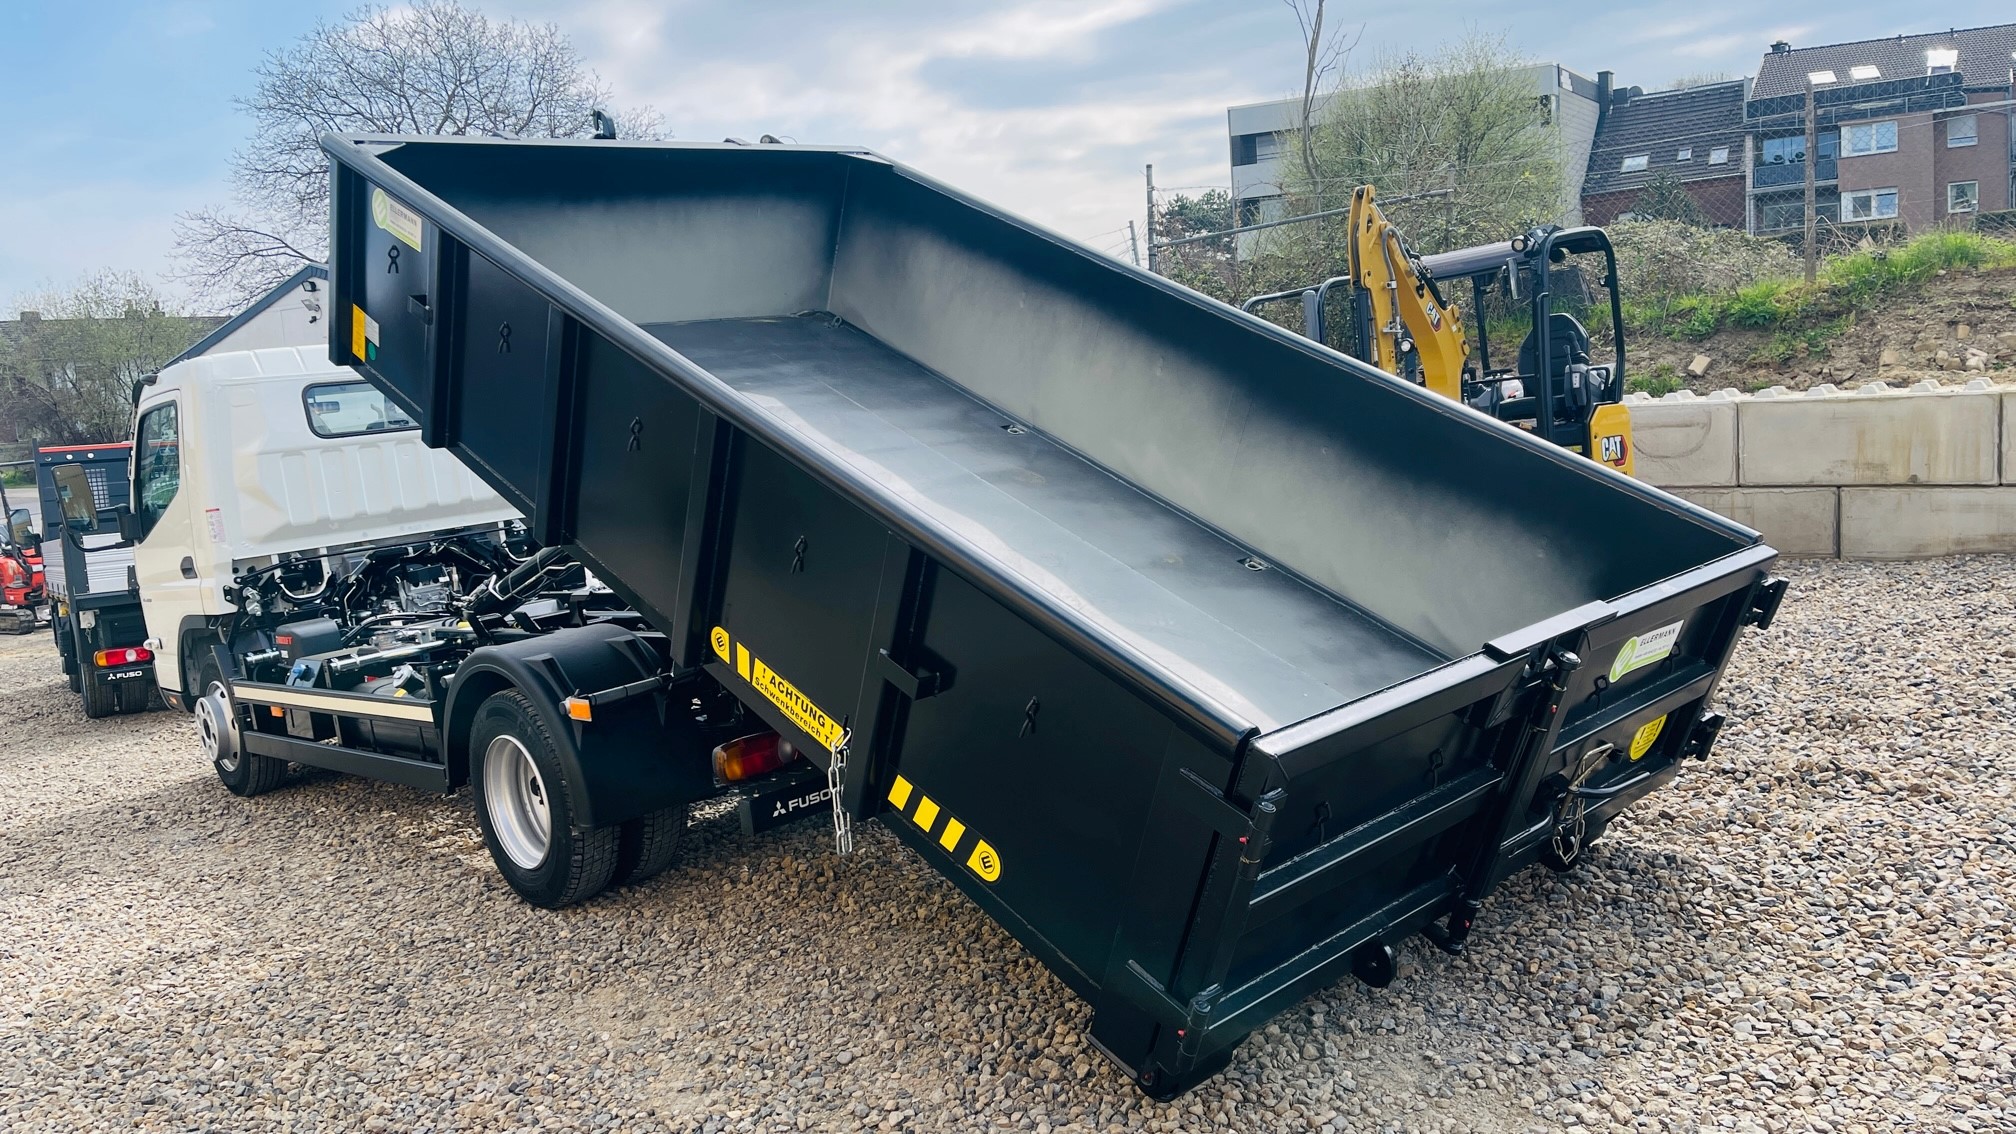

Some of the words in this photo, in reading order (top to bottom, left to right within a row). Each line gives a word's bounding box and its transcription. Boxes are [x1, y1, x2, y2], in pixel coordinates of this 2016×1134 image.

[1601, 436, 1622, 461] CAT
[1640, 627, 1677, 647] ELLERMANN
[116, 670, 143, 679] FUSO
[754, 676, 821, 737] Schwenkbereich
[769, 676, 826, 729] ACHTUNG
[788, 787, 832, 812] FUSO
